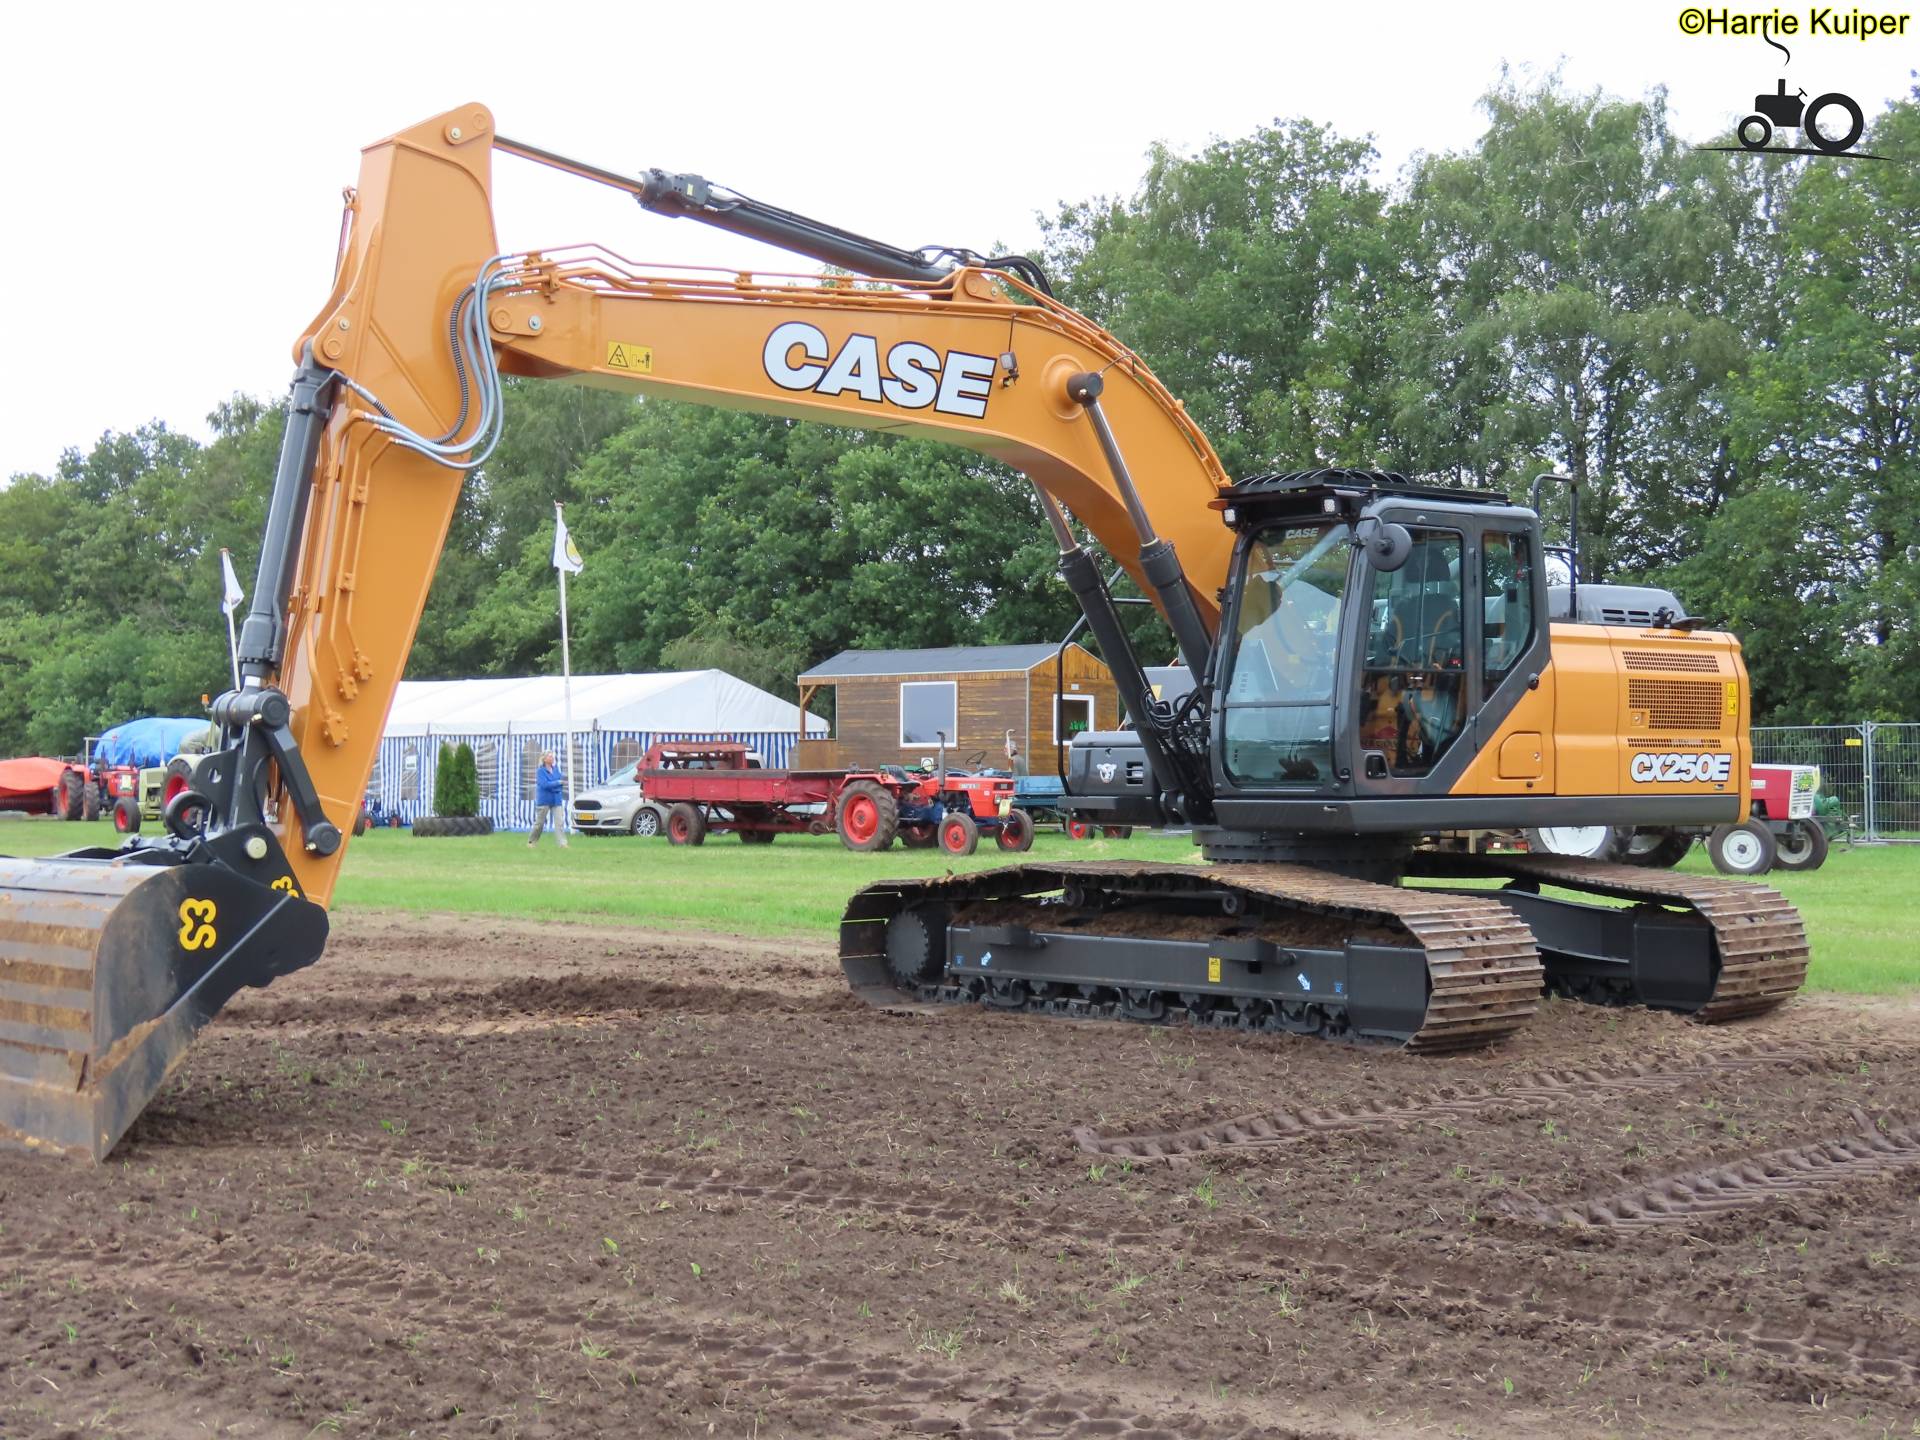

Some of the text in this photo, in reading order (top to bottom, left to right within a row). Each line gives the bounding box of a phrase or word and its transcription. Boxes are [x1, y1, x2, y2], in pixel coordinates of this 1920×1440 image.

[762, 321, 998, 419] CASE
[1285, 527, 1320, 539] CASE
[1630, 752, 1732, 783] CX250E
